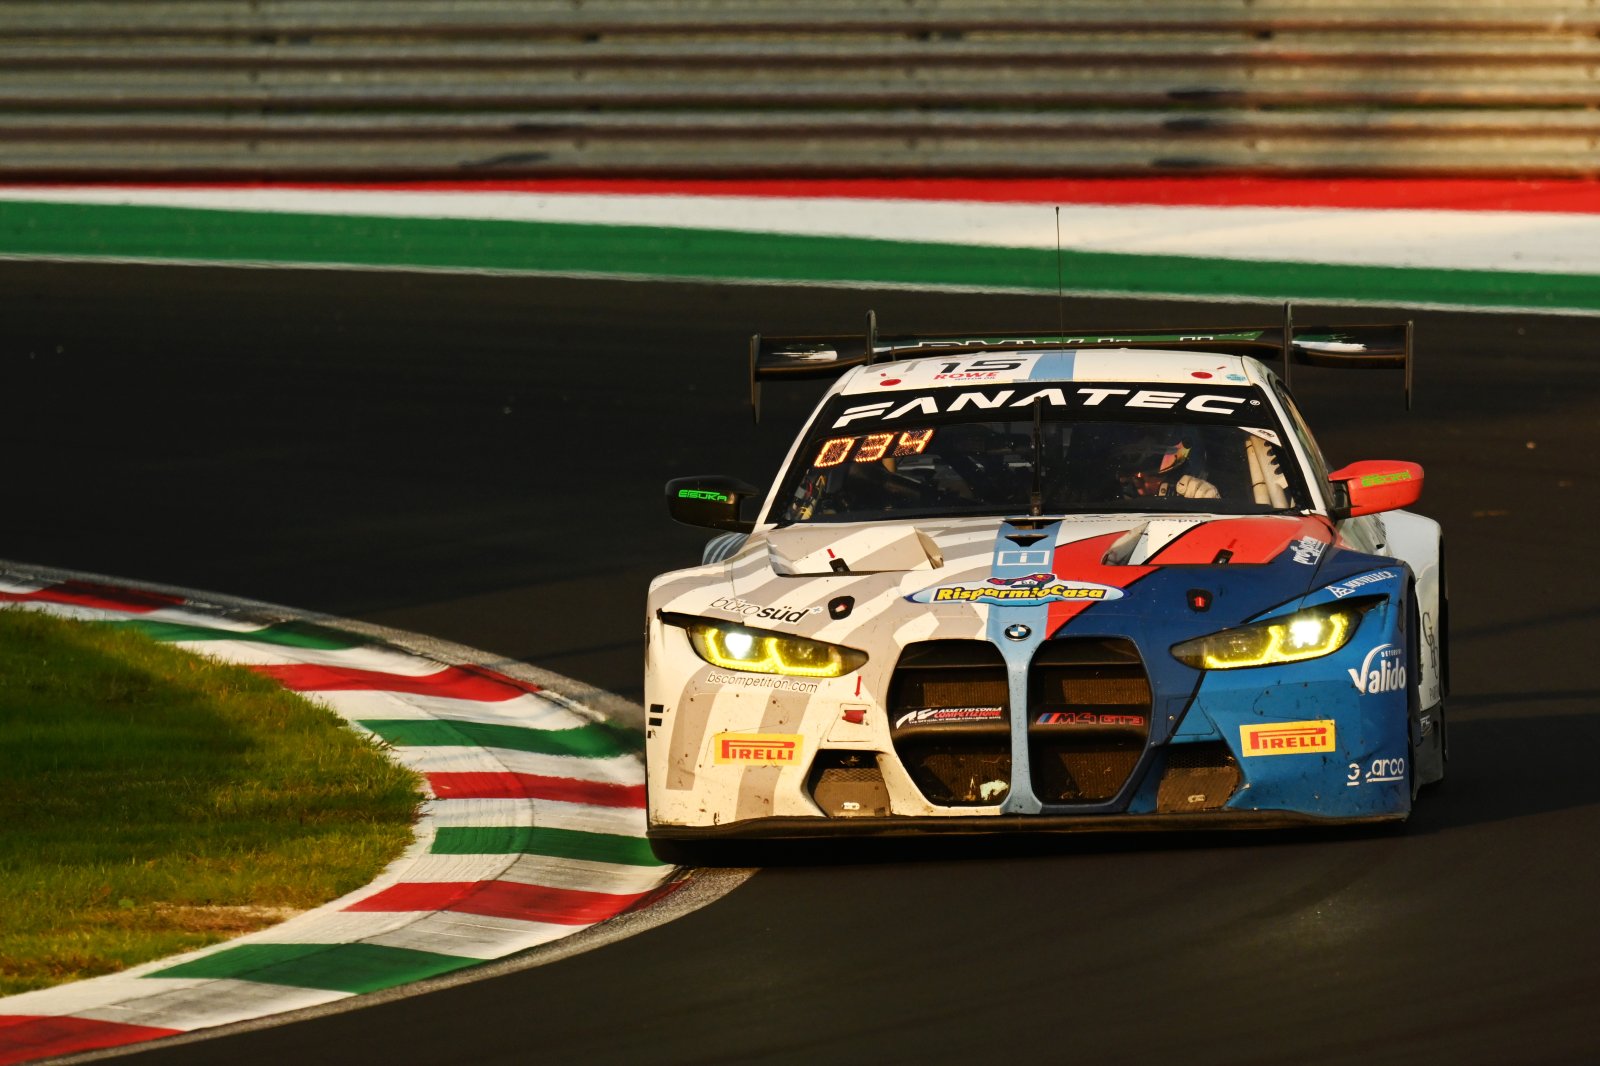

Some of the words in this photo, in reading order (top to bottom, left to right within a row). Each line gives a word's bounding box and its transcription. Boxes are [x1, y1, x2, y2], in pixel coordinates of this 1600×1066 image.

[933, 371, 1000, 380] ROWE
[940, 358, 1028, 374] 15
[832, 387, 1246, 429] FANATEC
[814, 429, 935, 468] 034
[1347, 643, 1406, 694] Valido
[707, 672, 818, 693] bscompetition.com
[1099, 714, 1144, 726] GT3
[1250, 726, 1327, 750] PIRELLI
[721, 739, 796, 761] PIRELLI
